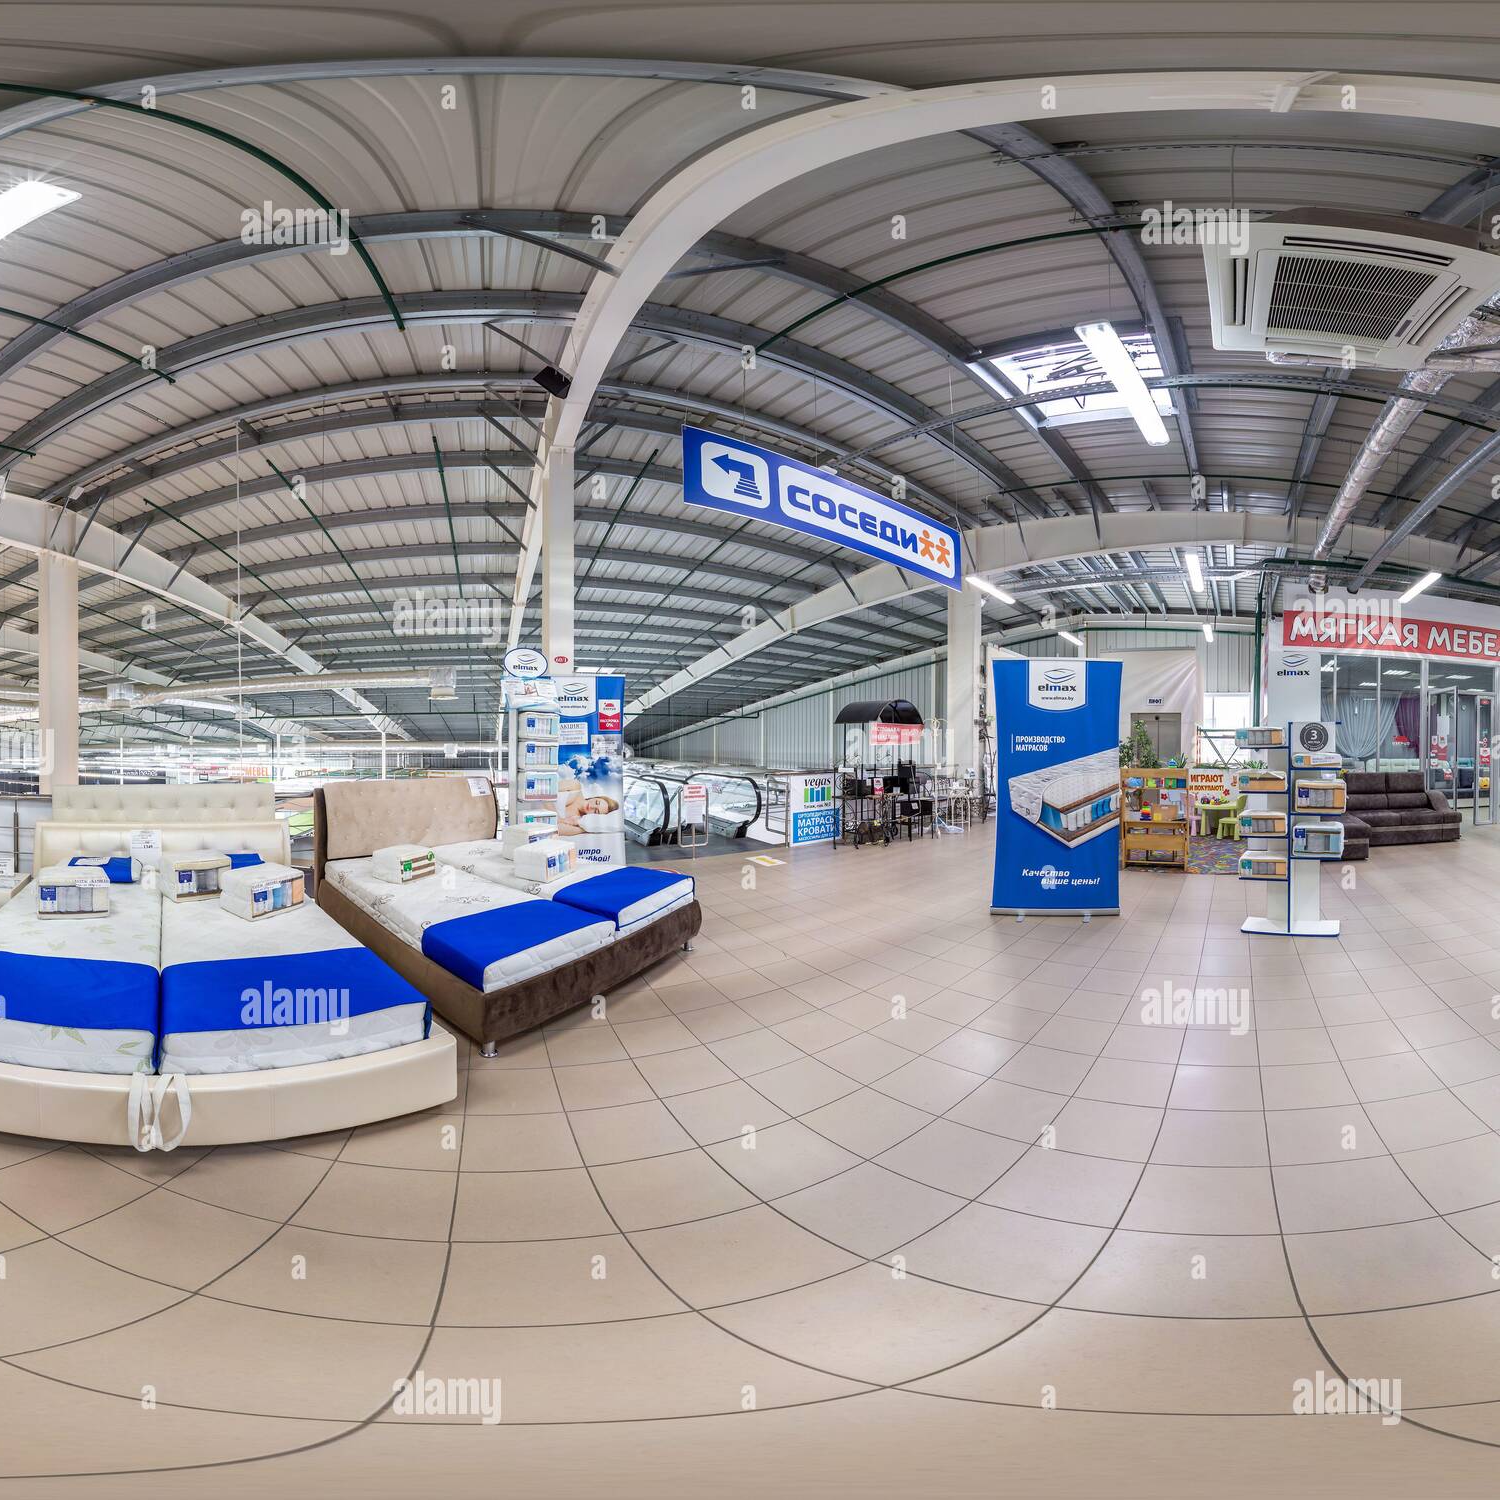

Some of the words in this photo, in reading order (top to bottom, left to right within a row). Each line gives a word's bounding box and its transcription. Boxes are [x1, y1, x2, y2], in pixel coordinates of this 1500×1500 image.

[787, 484, 918, 554] СОСЕДИ
[1290, 616, 1419, 649] МЯГКАЯ
[1427, 626, 1500, 656] МЕБЕ
[1277, 668, 1310, 676] elmax
[1037, 683, 1077, 691] elmax
[558, 694, 589, 702] elmax
[1310, 730, 1318, 740] 3
[1015, 735, 1066, 745] ПРОИЗВОДСТВО
[1015, 744, 1048, 752] МАТРАСОВ
[804, 777, 831, 789] vegas
[1190, 774, 1224, 783] ИГРАЮТ
[1071, 877, 1101, 886] цены!
